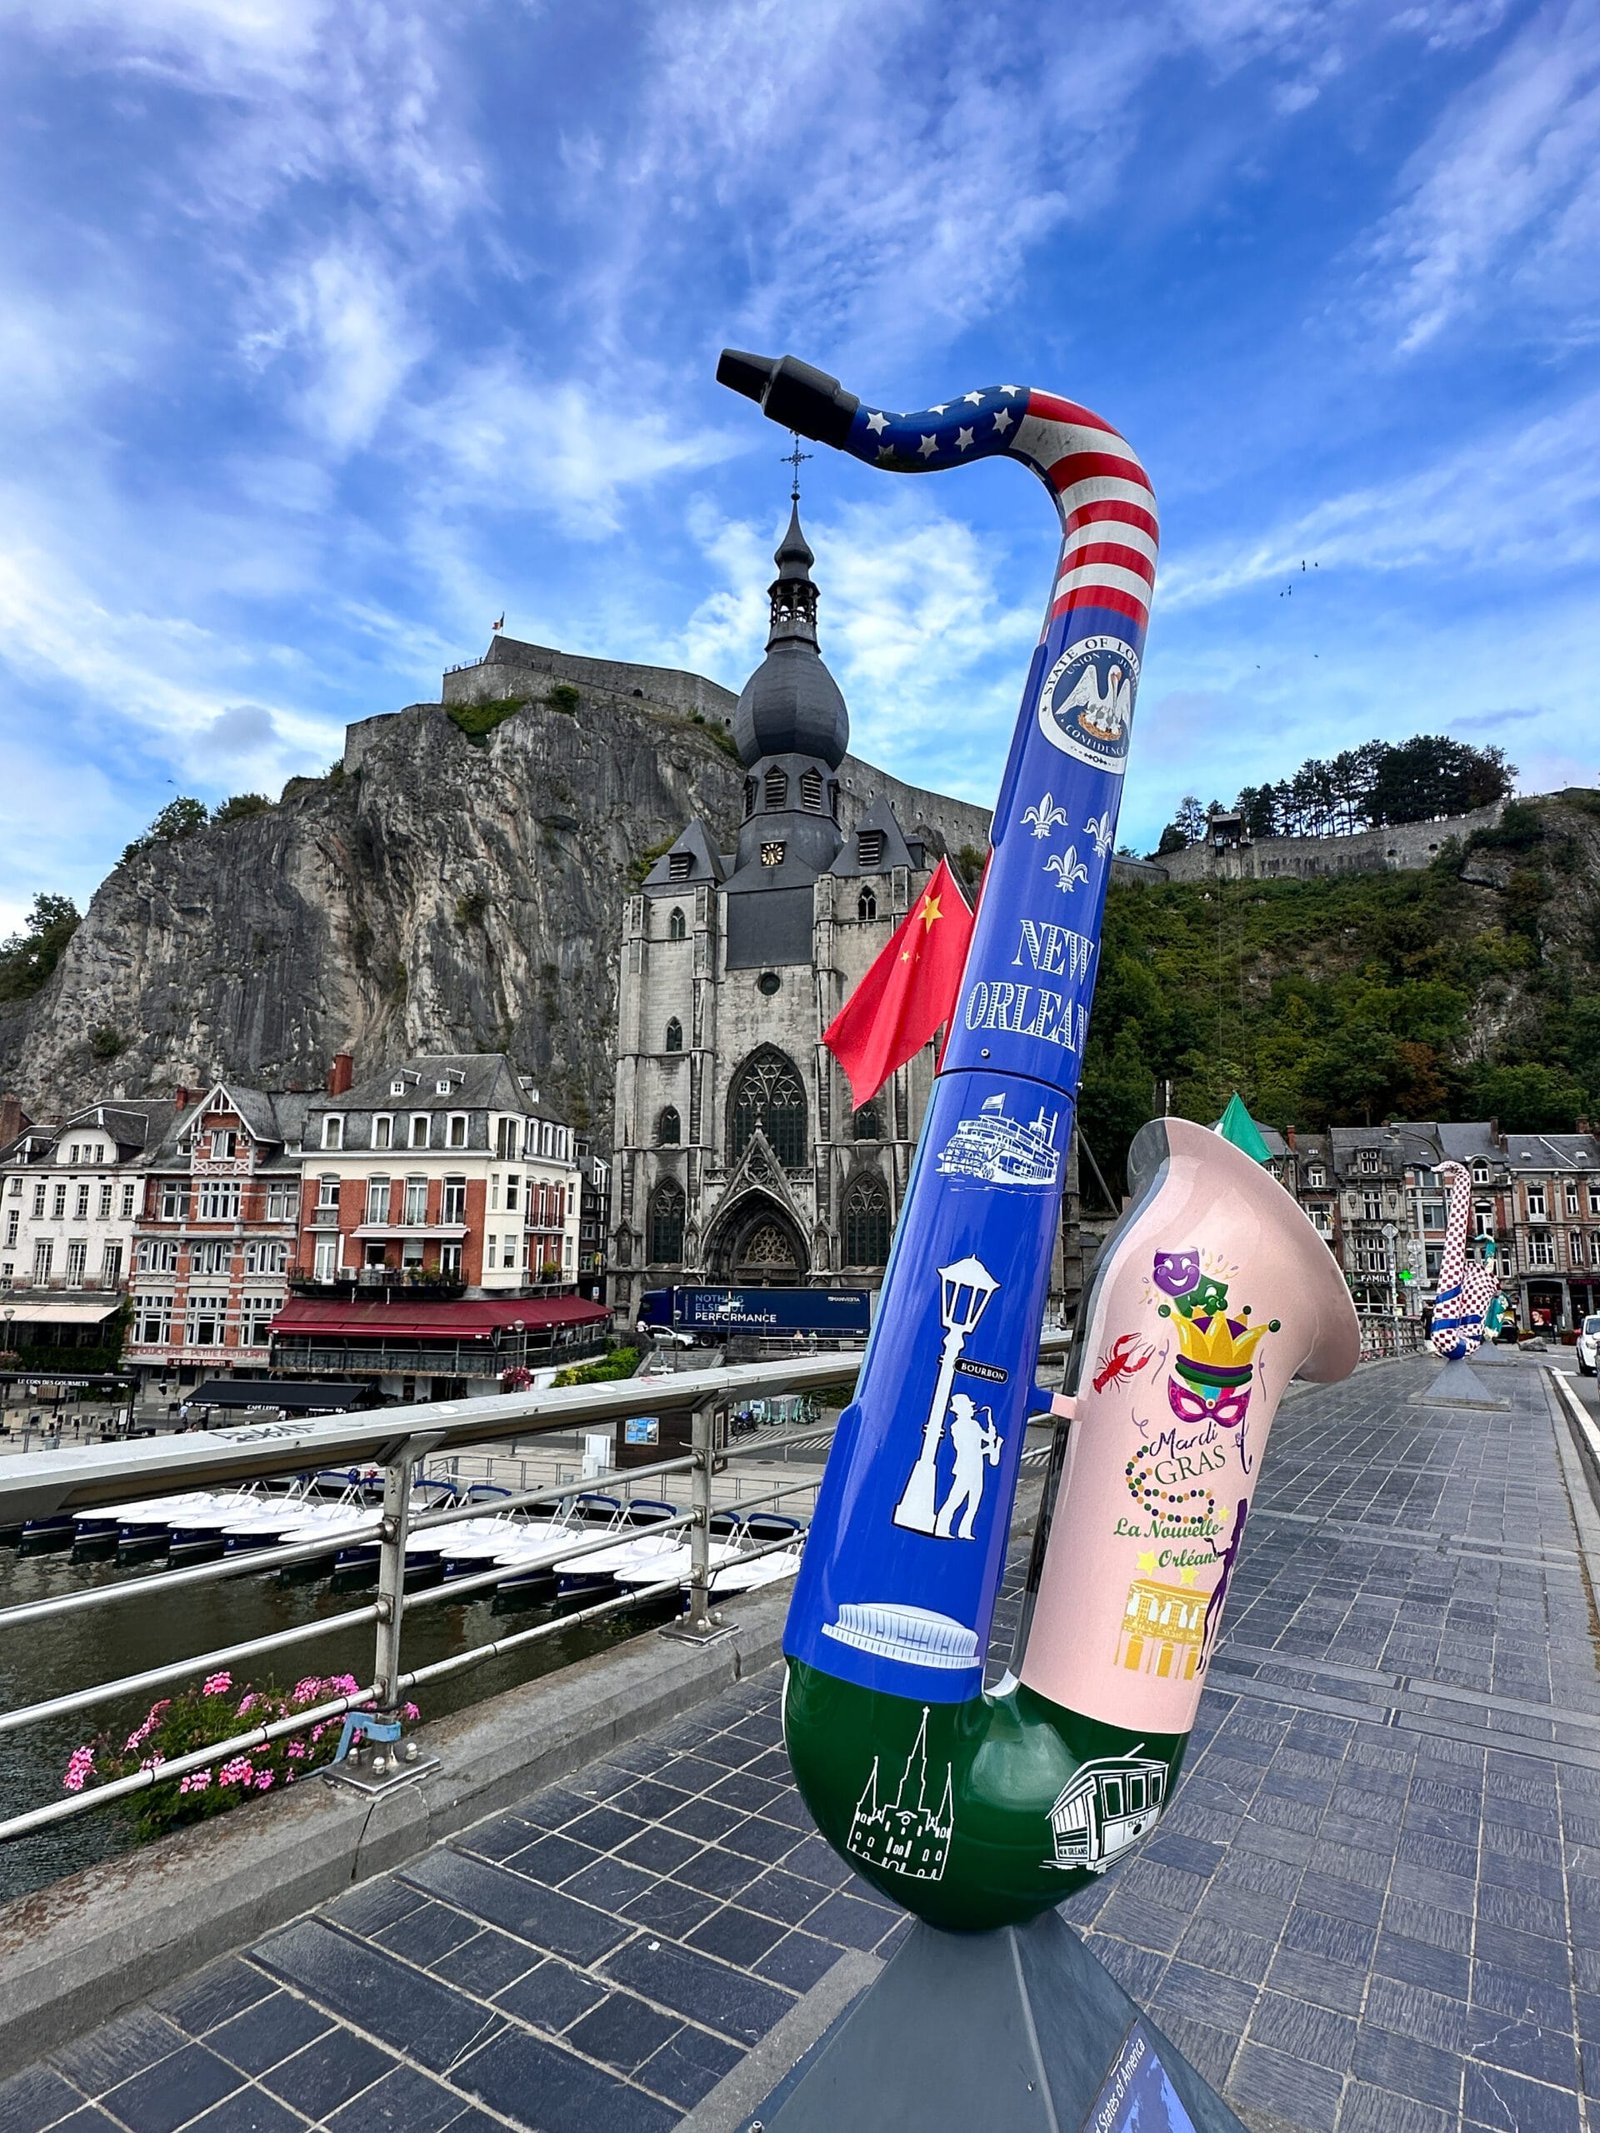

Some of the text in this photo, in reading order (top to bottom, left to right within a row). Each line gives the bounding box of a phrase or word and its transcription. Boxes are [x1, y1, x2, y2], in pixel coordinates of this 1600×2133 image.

[1044, 649, 1078, 695] STATE
[1085, 637, 1109, 650] OF
[1066, 652, 1101, 675] UNION
[1065, 724, 1125, 756] CONFIDENC
[1011, 919, 1095, 986] NEW
[695, 1312, 777, 1323] PERFORMANCE
[961, 1362, 1006, 1381] BOURBON
[1149, 1421, 1218, 1459] Mardi
[1155, 1445, 1226, 1485] GRAS
[1113, 1517, 1141, 1537] La
[1098, 2038, 1146, 2133] States of America
